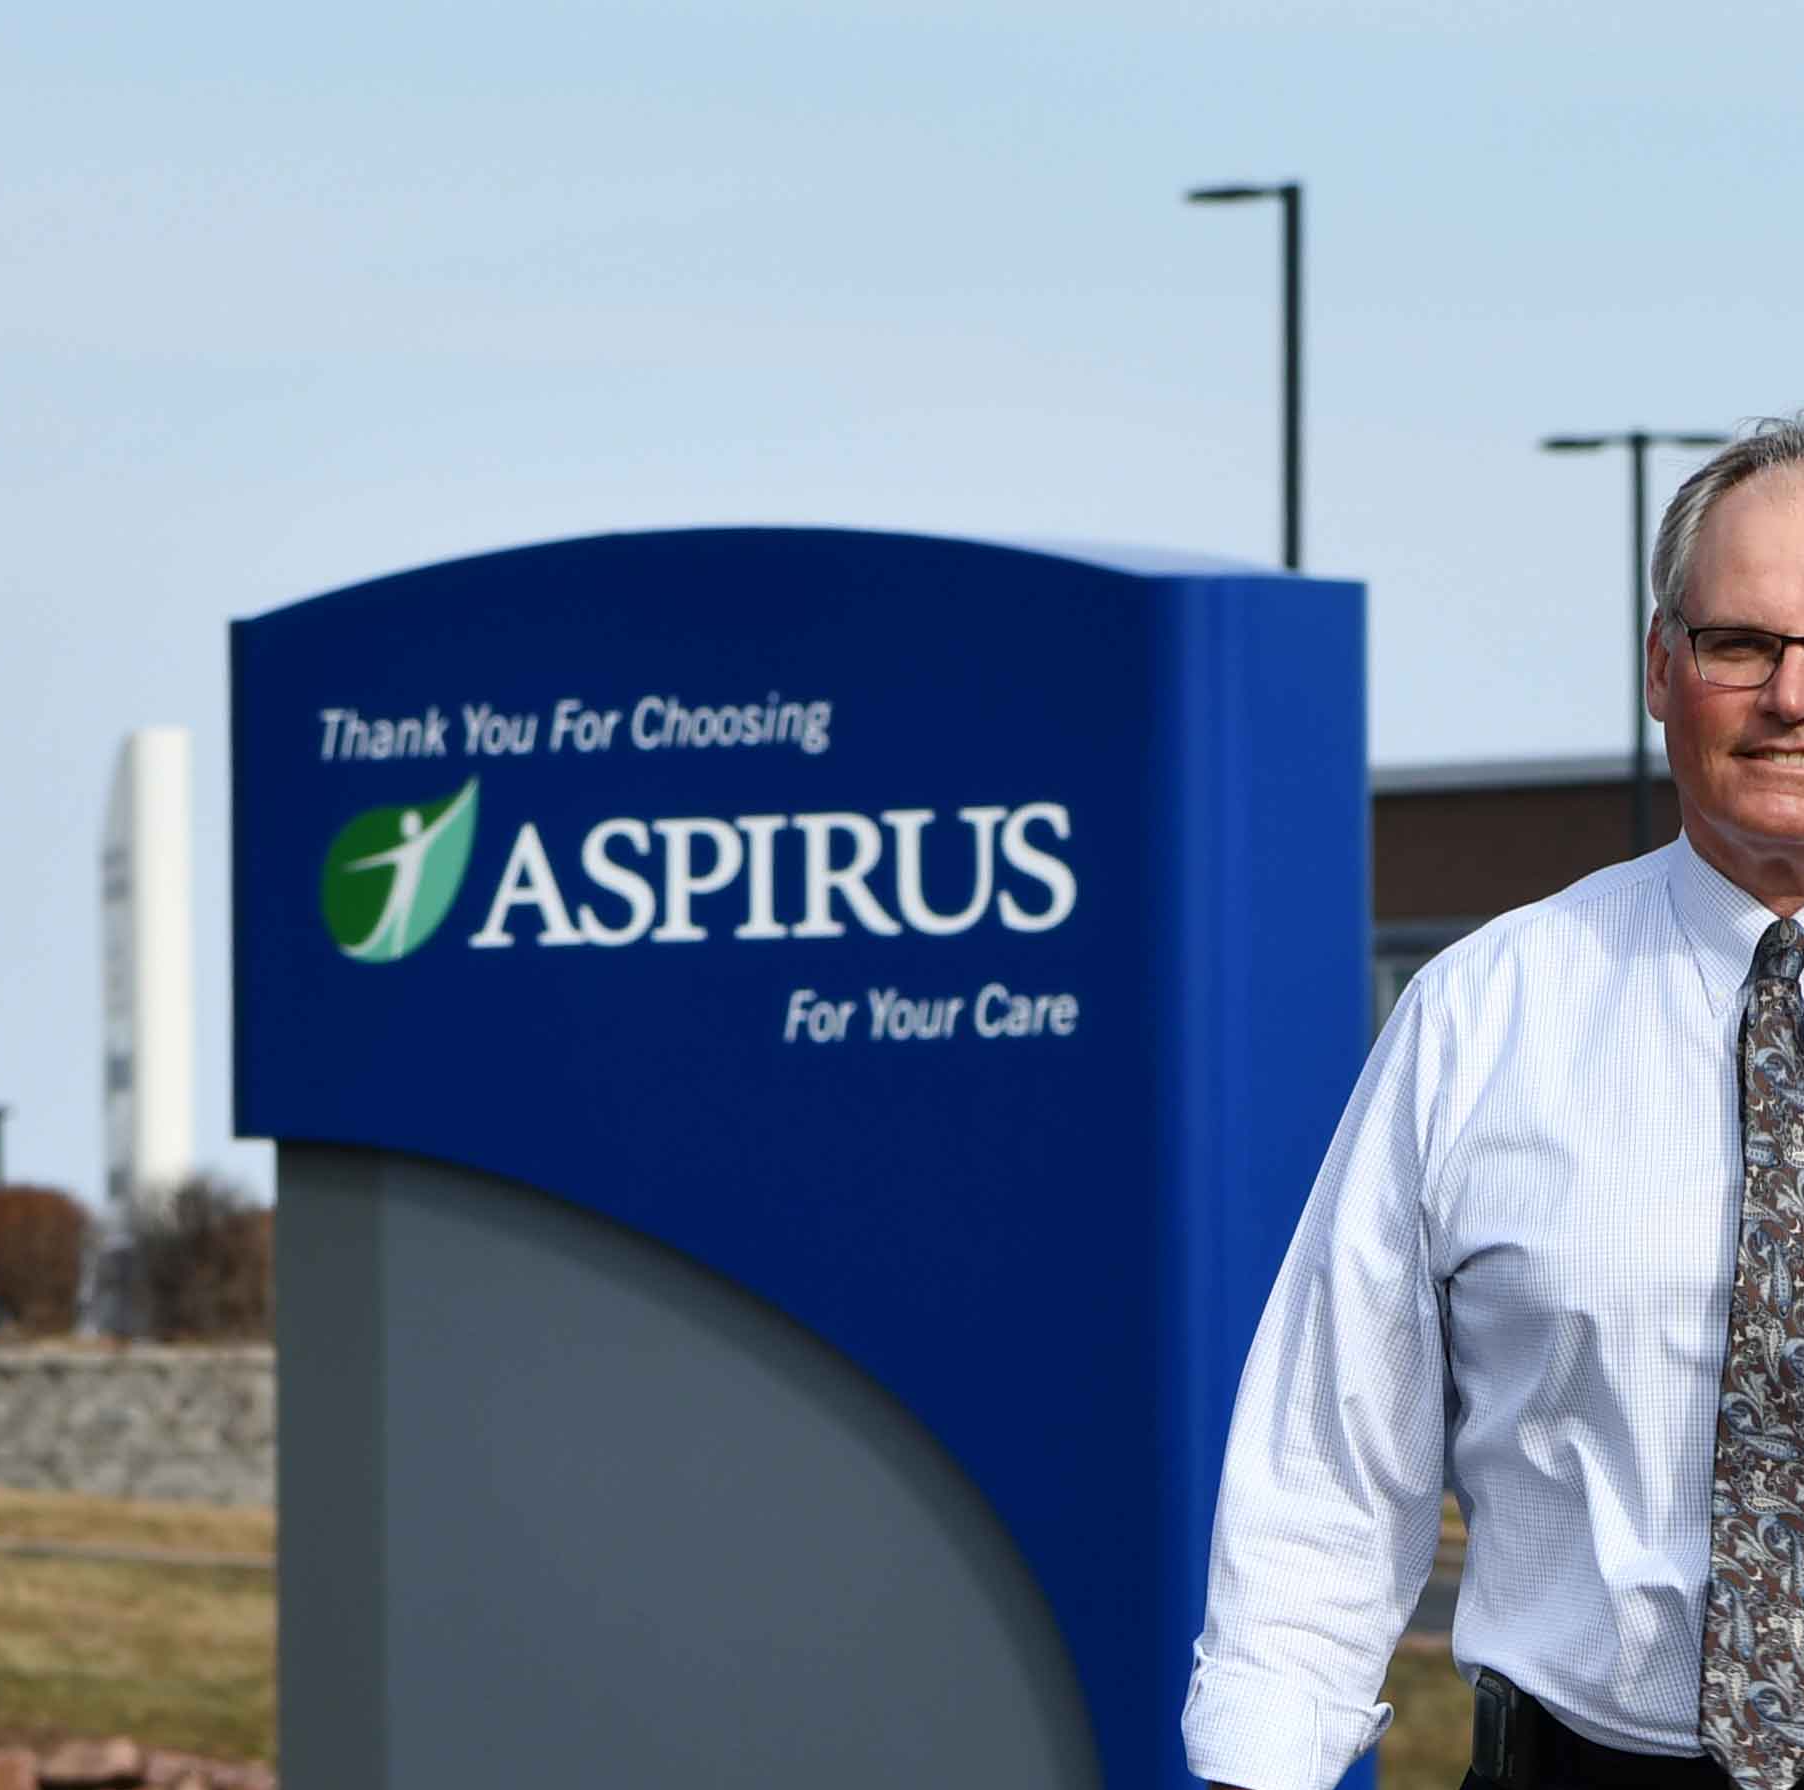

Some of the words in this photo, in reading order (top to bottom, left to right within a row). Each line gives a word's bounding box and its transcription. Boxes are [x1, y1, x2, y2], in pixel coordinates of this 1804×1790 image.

[320, 708, 448, 760] Thank
[462, 704, 538, 755] You
[549, 699, 622, 752] For
[630, 692, 832, 755] Choosing
[468, 802, 1078, 949] ASPIRUS
[783, 989, 855, 1043] For
[868, 988, 965, 1041] Your
[973, 983, 1080, 1038] Care
